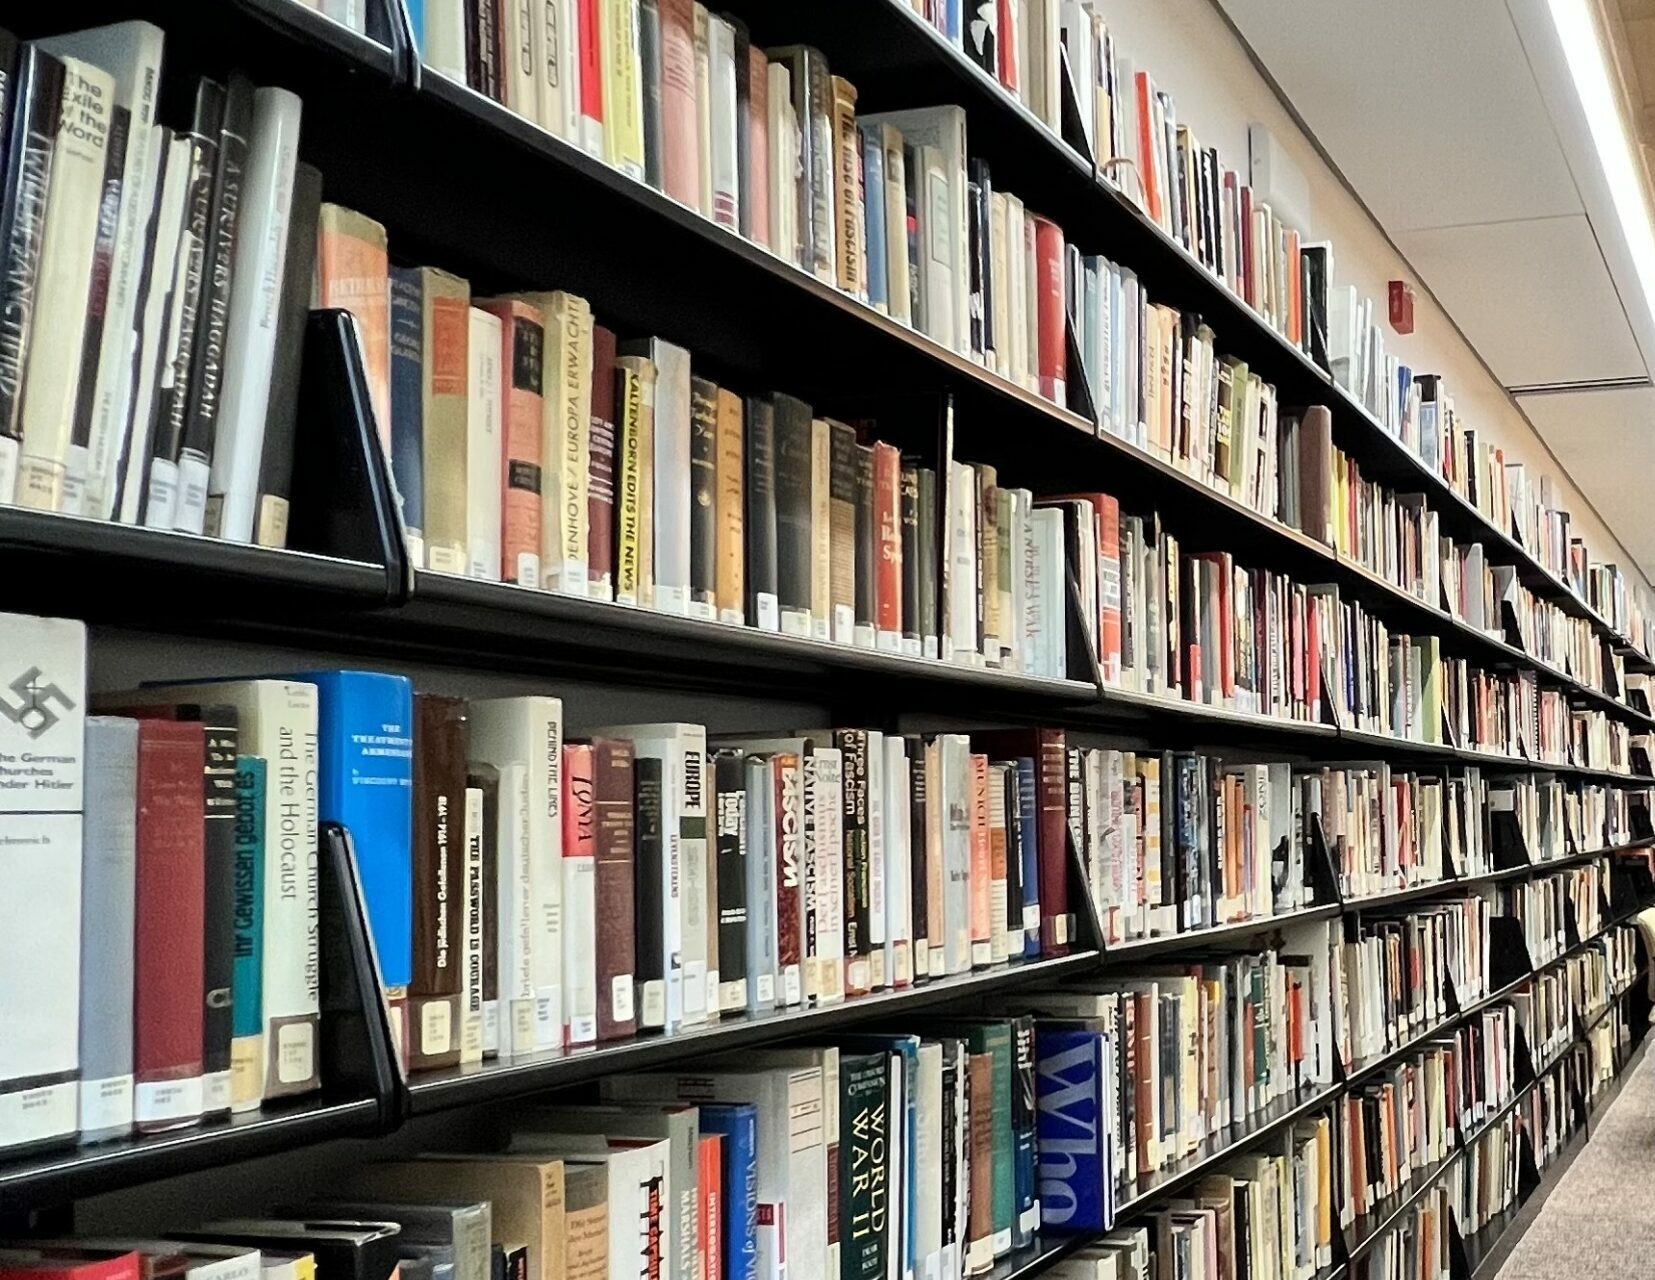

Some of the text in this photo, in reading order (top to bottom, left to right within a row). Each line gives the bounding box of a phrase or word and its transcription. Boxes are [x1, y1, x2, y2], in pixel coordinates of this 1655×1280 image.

[62, 88, 104, 115] Exile
[66, 71, 103, 97] The
[79, 105, 107, 135] the
[199, 160, 242, 419] A HAGGADAH
[566, 402, 582, 463] EUROPA
[621, 373, 640, 592] KALTENBORN EDITS THE NEWS
[0, 752, 77, 765] he German
[0, 766, 54, 777] hurches
[546, 720, 559, 762] BEHIND
[843, 733, 856, 816] of Fascism
[33, 778, 75, 790] Hitler
[684, 750, 701, 810] EUROPE
[856, 730, 868, 826] Three Faces
[975, 756, 987, 826] MUNICH
[279, 726, 301, 901] and the Holocaust
[469, 834, 482, 862] THE
[782, 766, 799, 888] FASCISM
[803, 755, 817, 912] NATIVE FASCISM
[235, 848, 255, 937] Gewissen
[469, 865, 481, 935] PASSWORD
[469, 953, 481, 1013] COURAGE
[1037, 1036, 1098, 1226] Who
[745, 1159, 759, 1229] VISIONS
[852, 1106, 870, 1241] WAR II
[869, 1101, 887, 1234] WORLD
[649, 1188, 661, 1220] TIME
[679, 1190, 690, 1272] MARSHALS
[742, 1239, 755, 1255] of
